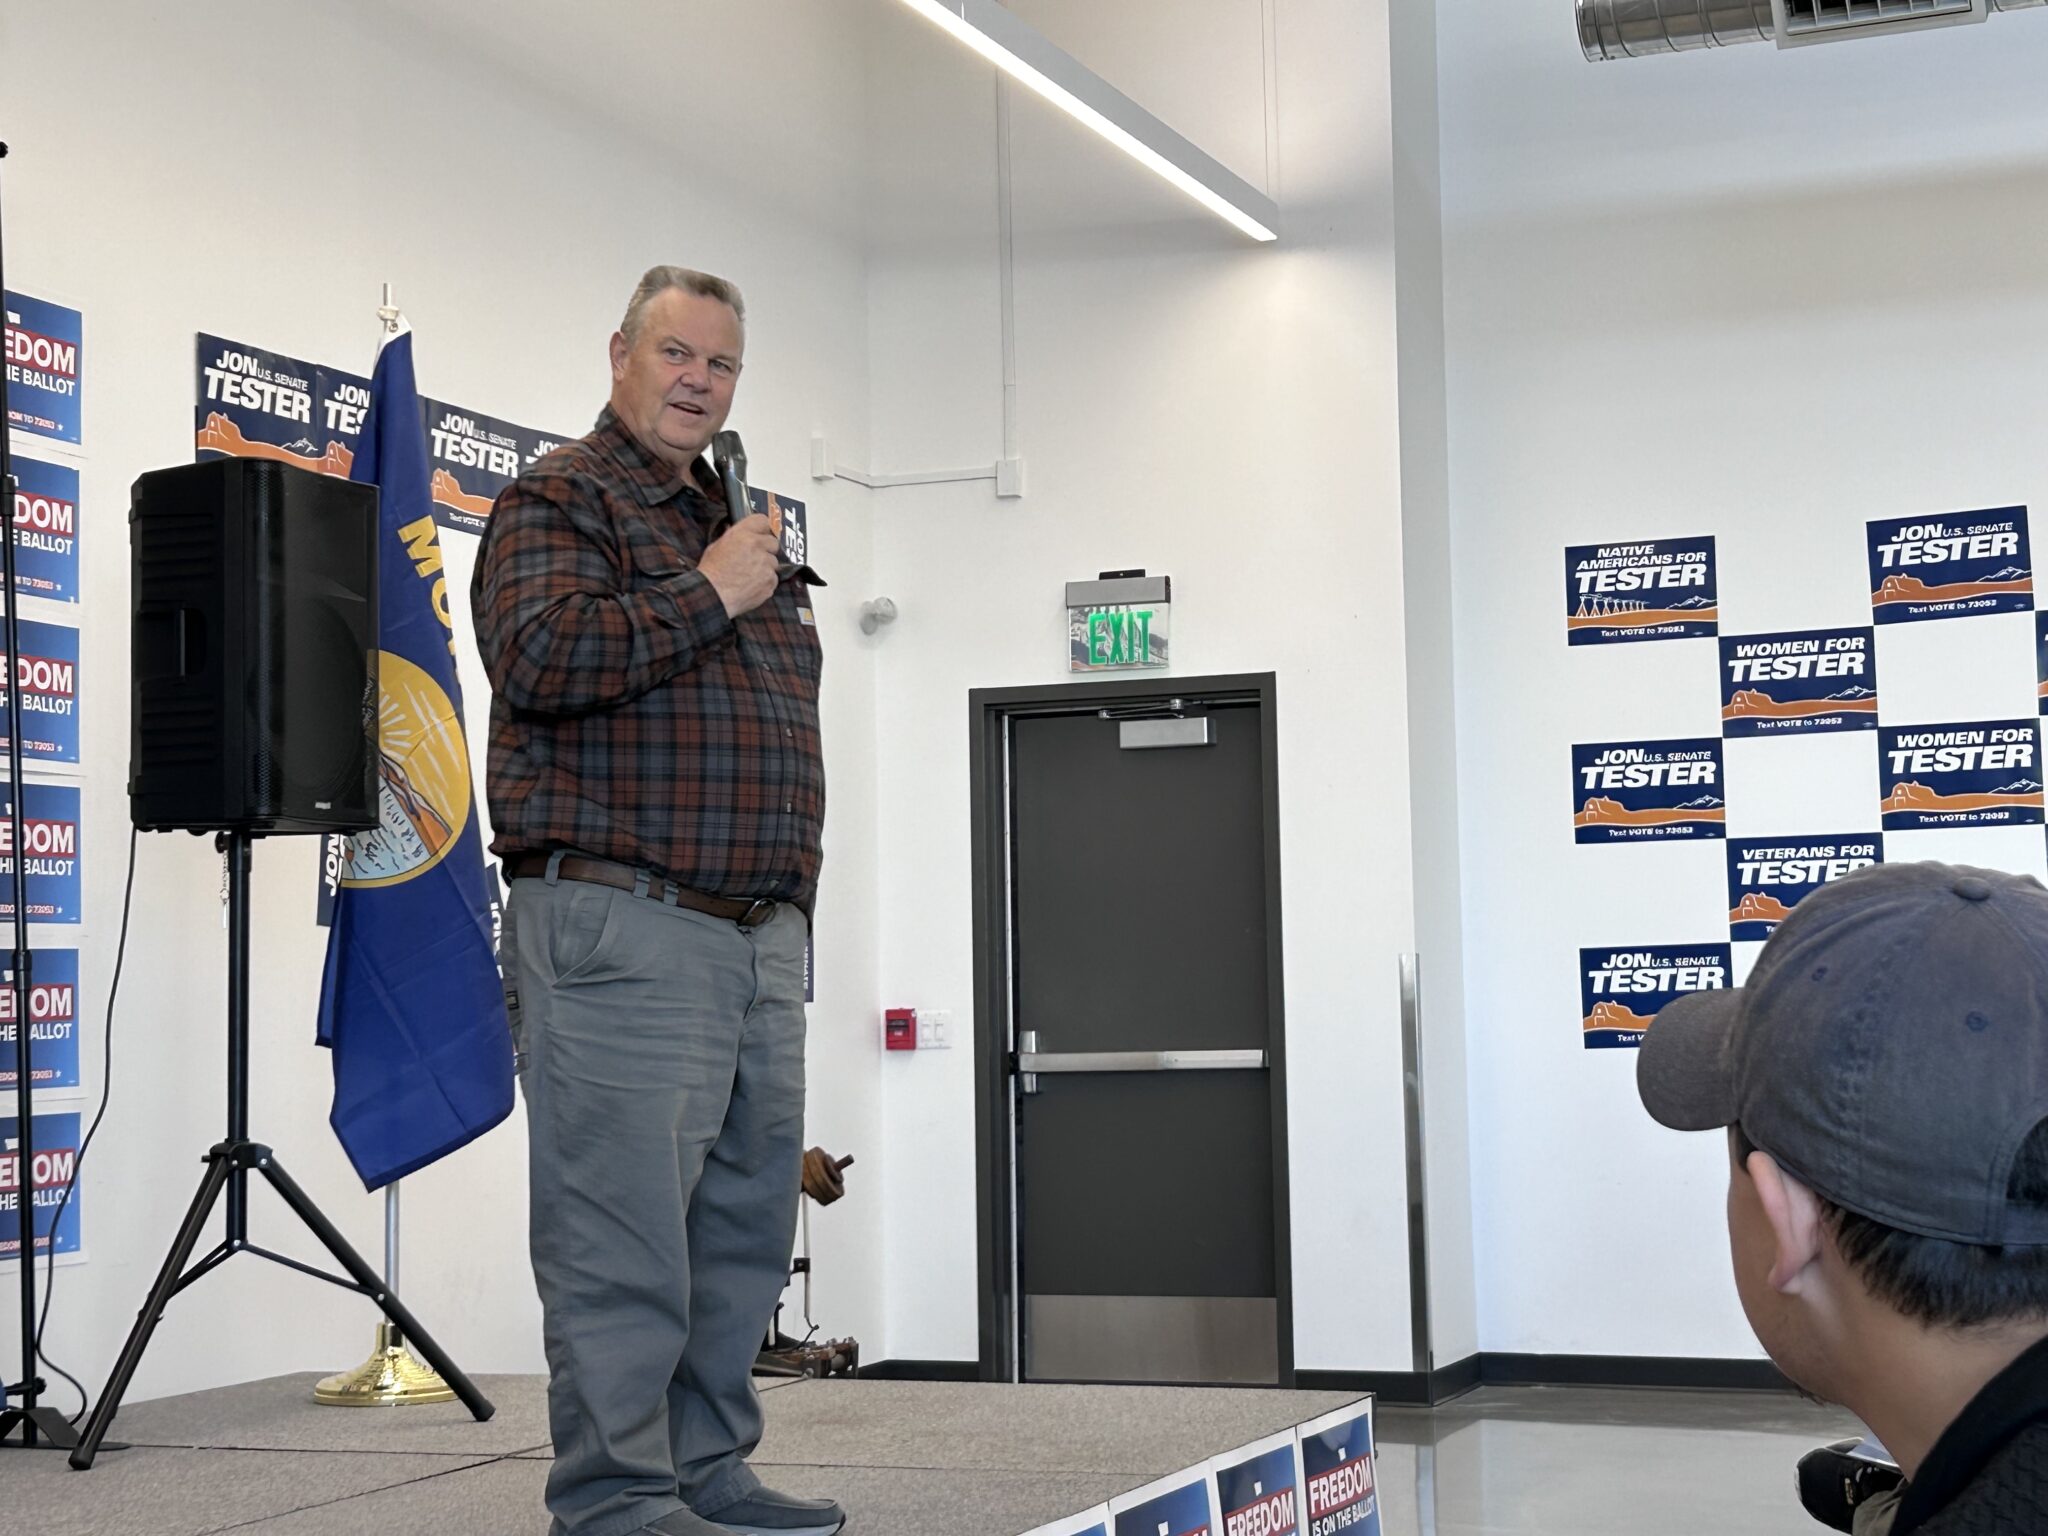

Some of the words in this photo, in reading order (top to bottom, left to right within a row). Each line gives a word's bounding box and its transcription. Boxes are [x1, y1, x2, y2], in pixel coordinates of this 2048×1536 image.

[23, 368, 75, 396] BALLOT
[216, 350, 258, 377] JON
[257, 366, 273, 381] U.S.
[275, 372, 309, 392] SENATE
[204, 367, 311, 424] TESTER
[334, 384, 370, 409] JON
[440, 413, 474, 437] JON
[431, 428, 519, 479] TESTER
[22, 530, 73, 555] BALLOT
[1891, 523, 1943, 542] JON
[1943, 527, 1963, 537] U.S.
[1967, 522, 2013, 535] SENATE
[1597, 544, 1655, 558] NATIVE
[1877, 532, 2019, 567] TESTER
[1577, 554, 1673, 570] AMERICANS
[1676, 552, 1707, 564] FOR
[1575, 563, 1708, 593] TESTER
[1929, 603, 1955, 612] VOTE
[1088, 611, 1153, 665] EXIT
[1620, 627, 1645, 636] VOTE
[1736, 640, 1819, 657] WOMEN
[1825, 637, 1865, 651] FOR
[1728, 652, 1866, 682] TESTER
[23, 694, 73, 715] BALLOT
[1757, 721, 1775, 729] Text
[1777, 719, 1802, 728] VOTE
[1897, 730, 1984, 748] WOMEN
[1990, 728, 2034, 743] FOR
[1594, 749, 1645, 765] JON
[1644, 753, 1664, 763] U.S.
[1667, 751, 1711, 762] SENATE
[1888, 744, 2034, 774] TESTER
[1580, 761, 1717, 789] TESTER
[1919, 815, 1938, 823] Text
[1940, 813, 1967, 822] VOTE
[1628, 827, 1654, 836] VOTE
[1742, 846, 1835, 860] VETERANS
[1840, 845, 1875, 857] FOR
[1602, 953, 1651, 969] JON
[1651, 958, 1671, 967] U.S.
[1675, 956, 1720, 966] SENATE
[1588, 966, 1725, 994] TESTER
[30, 1023, 72, 1040] ALLOT
[1617, 1034, 1635, 1042] Text
[32, 1188, 73, 1207] ALLOT
[1309, 1456, 1372, 1514] FREEDOM
[1228, 1491, 1295, 1536] FREEDOM
[1312, 1520, 1322, 1536] IS
[1322, 1514, 1336, 1536] ON
[1336, 1507, 1352, 1530] THE
[1352, 1495, 1376, 1523] BALLOT
